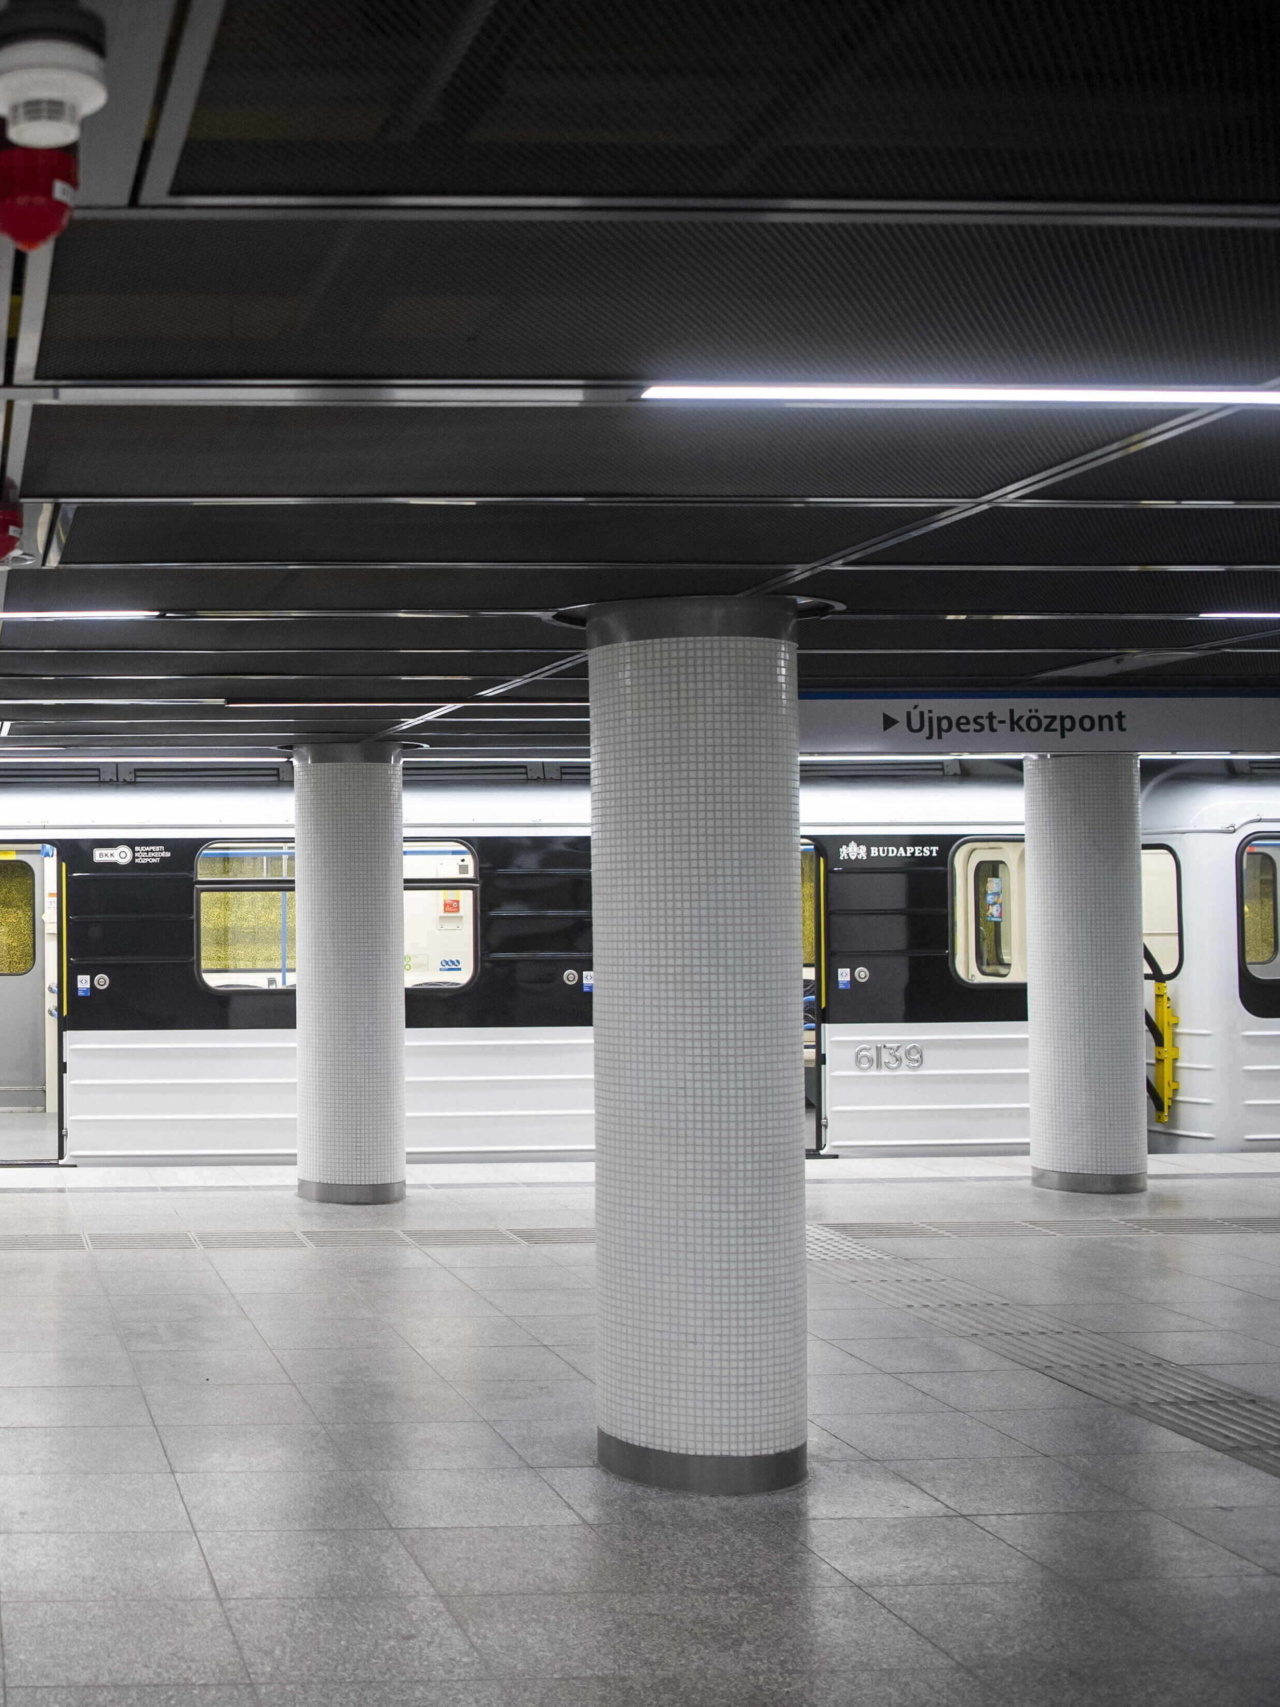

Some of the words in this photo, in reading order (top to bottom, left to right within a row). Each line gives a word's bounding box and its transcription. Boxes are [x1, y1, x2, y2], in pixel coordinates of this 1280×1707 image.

[906, 704, 1127, 740] Újpest-központ
[870, 846, 939, 857] BUDAPEST
[854, 1043, 924, 1071] 6139
